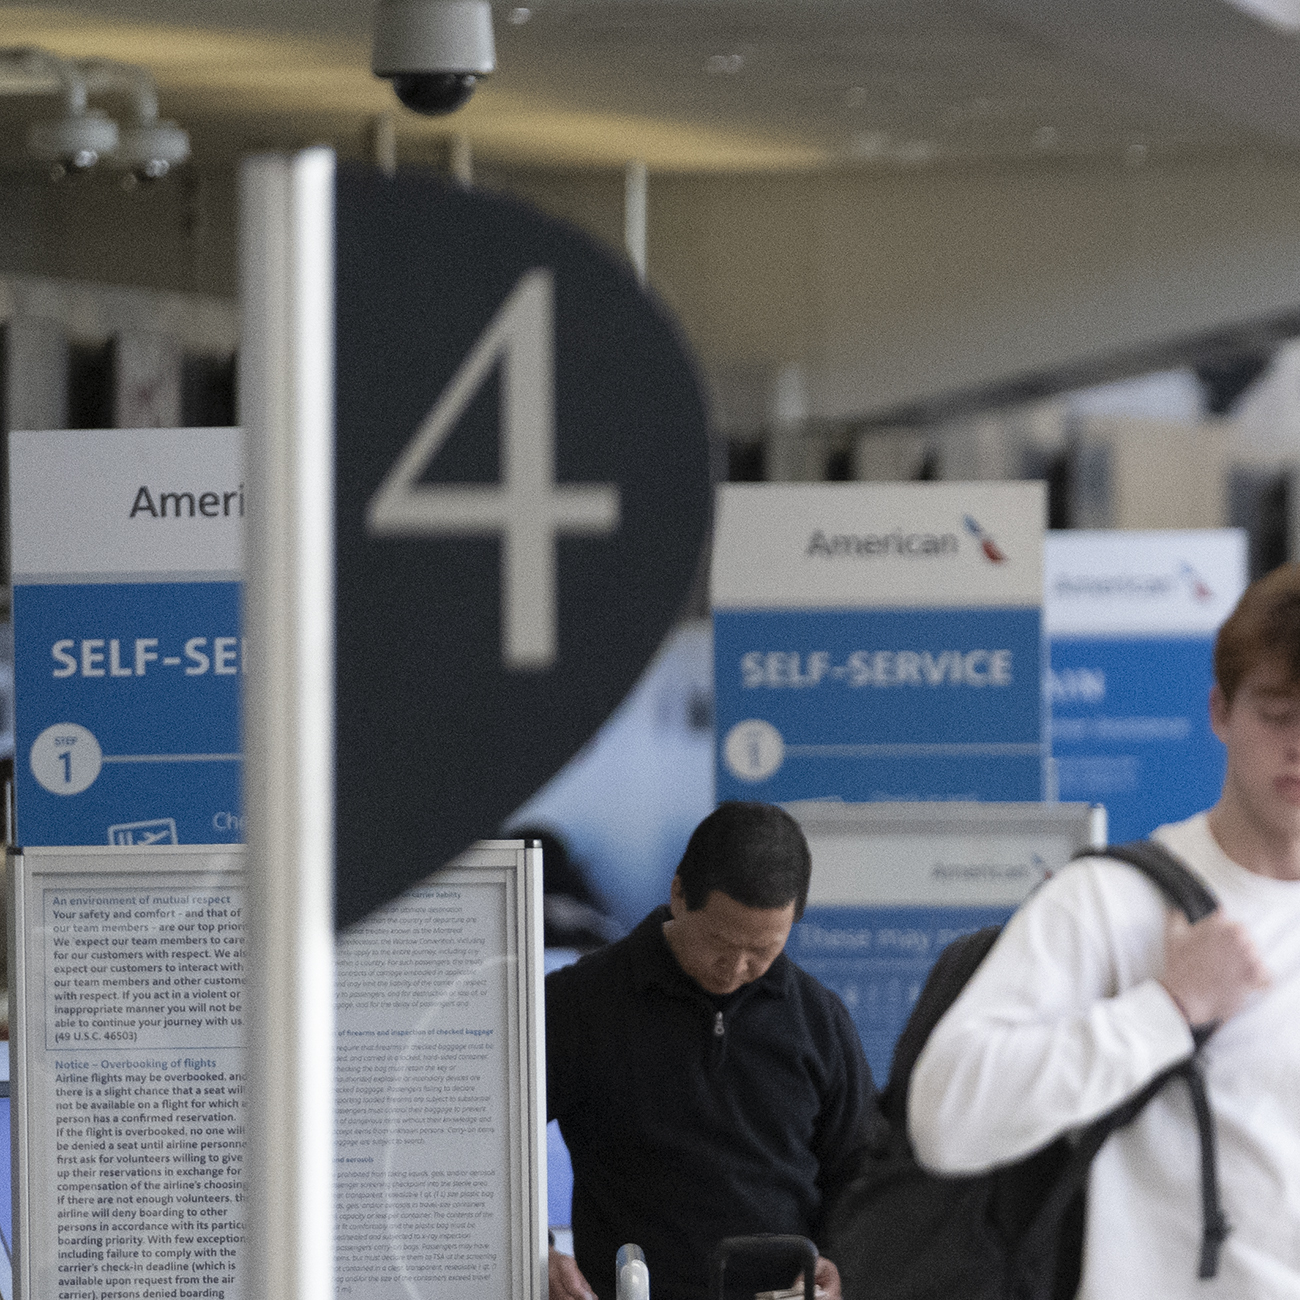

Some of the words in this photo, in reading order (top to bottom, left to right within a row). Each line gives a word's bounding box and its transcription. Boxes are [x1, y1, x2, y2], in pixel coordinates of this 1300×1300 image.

[366, 264, 621, 672] 4
[129, 484, 245, 519] Ameri
[806, 529, 958, 557] American
[52, 636, 246, 679] SELF-SE
[741, 649, 1014, 688] SELF-SERVICE
[58, 751, 72, 784] 1
[53, 894, 66, 905] An
[70, 895, 136, 905] environment
[139, 894, 149, 904] of
[153, 893, 189, 904] mutual
[192, 894, 231, 907] respect
[53, 908, 76, 919] Your
[79, 908, 110, 921] safety
[114, 907, 131, 918] and
[134, 907, 175, 918] comfort
[185, 907, 203, 917] and
[207, 907, 227, 917] that
[231, 906, 241, 917] of
[54, 936, 69, 946] We
[75, 936, 109, 949] expect
[112, 938, 128, 946] our
[132, 935, 157, 945] team
[160, 934, 207, 945] members
[210, 935, 220, 945] to
[224, 936, 245, 944] care
[54, 949, 68, 959] for
[71, 951, 87, 959] our
[91, 949, 143, 959] customers
[146, 948, 169, 959] with
[172, 948, 212, 961] respect.
[215, 947, 230, 958] We
[54, 990, 76, 1001] with
[80, 990, 119, 1003] respect.
[123, 989, 130, 1000] If
[133, 992, 151, 1003] you
[154, 990, 169, 999] act
[172, 989, 181, 999] in
[184, 991, 189, 999] a
[193, 988, 227, 999] violent
[230, 990, 241, 998] or
[55, 1004, 123, 1017] inappropriate
[126, 1005, 164, 1013] manner
[167, 1005, 185, 1016] you
[189, 1002, 206, 1012] will
[209, 1002, 226, 1012] not
[229, 1001, 241, 1012] be
[55, 1017, 75, 1027] able
[79, 1017, 89, 1027] to
[92, 1017, 136, 1027] continue
[139, 1018, 161, 1029] your
[163, 1018, 202, 1029] journey
[205, 1015, 228, 1025] with
[231, 1017, 245, 1025] us.
[55, 1058, 89, 1069] Notice
[101, 1058, 168, 1072] Overbooking
[171, 1058, 182, 1068] of
[184, 1057, 216, 1071] flights
[55, 1072, 88, 1083] Airline
[92, 1072, 122, 1085] flights
[125, 1074, 147, 1085] may
[149, 1071, 161, 1082] be
[164, 1071, 227, 1083] overbooked,
[56, 1115, 90, 1126] person
[93, 1112, 110, 1122] has
[113, 1114, 118, 1122] a
[121, 1111, 173, 1122] confirmed
[176, 1111, 236, 1122] reservation.
[57, 1126, 64, 1136] If
[67, 1126, 83, 1136] the
[86, 1125, 112, 1139] flight
[115, 1126, 123, 1136] is
[126, 1125, 188, 1137] overbooked,
[191, 1127, 203, 1135] no
[206, 1127, 224, 1135] one
[57, 1153, 77, 1163] first
[80, 1153, 96, 1163] ask
[99, 1152, 114, 1163] for
[116, 1152, 170, 1163] volunteers
[173, 1152, 206, 1165] willing
[209, 1152, 219, 1162] to
[222, 1152, 243, 1165] give
[57, 1169, 70, 1180] up
[73, 1166, 97, 1177] their
[99, 1166, 162, 1177] reservations
[165, 1166, 173, 1176] in
[176, 1165, 224, 1179] exchange
[227, 1165, 241, 1175] for
[58, 1207, 88, 1218] airline
[92, 1207, 109, 1217] will
[112, 1206, 136, 1220] deny
[139, 1206, 184, 1220] boarding
[187, 1207, 197, 1216] to
[200, 1205, 227, 1216] other
[58, 1247, 104, 1261] including
[106, 1247, 139, 1258] failure
[142, 1248, 152, 1258] to
[155, 1247, 191, 1260] comply
[194, 1246, 217, 1257] with
[220, 1246, 236, 1257] the
[59, 1275, 103, 1286] available
[106, 1277, 131, 1288] upon
[134, 1275, 172, 1288] request
[175, 1274, 200, 1284] from
[202, 1273, 219, 1284] the
[222, 1274, 235, 1284] air
